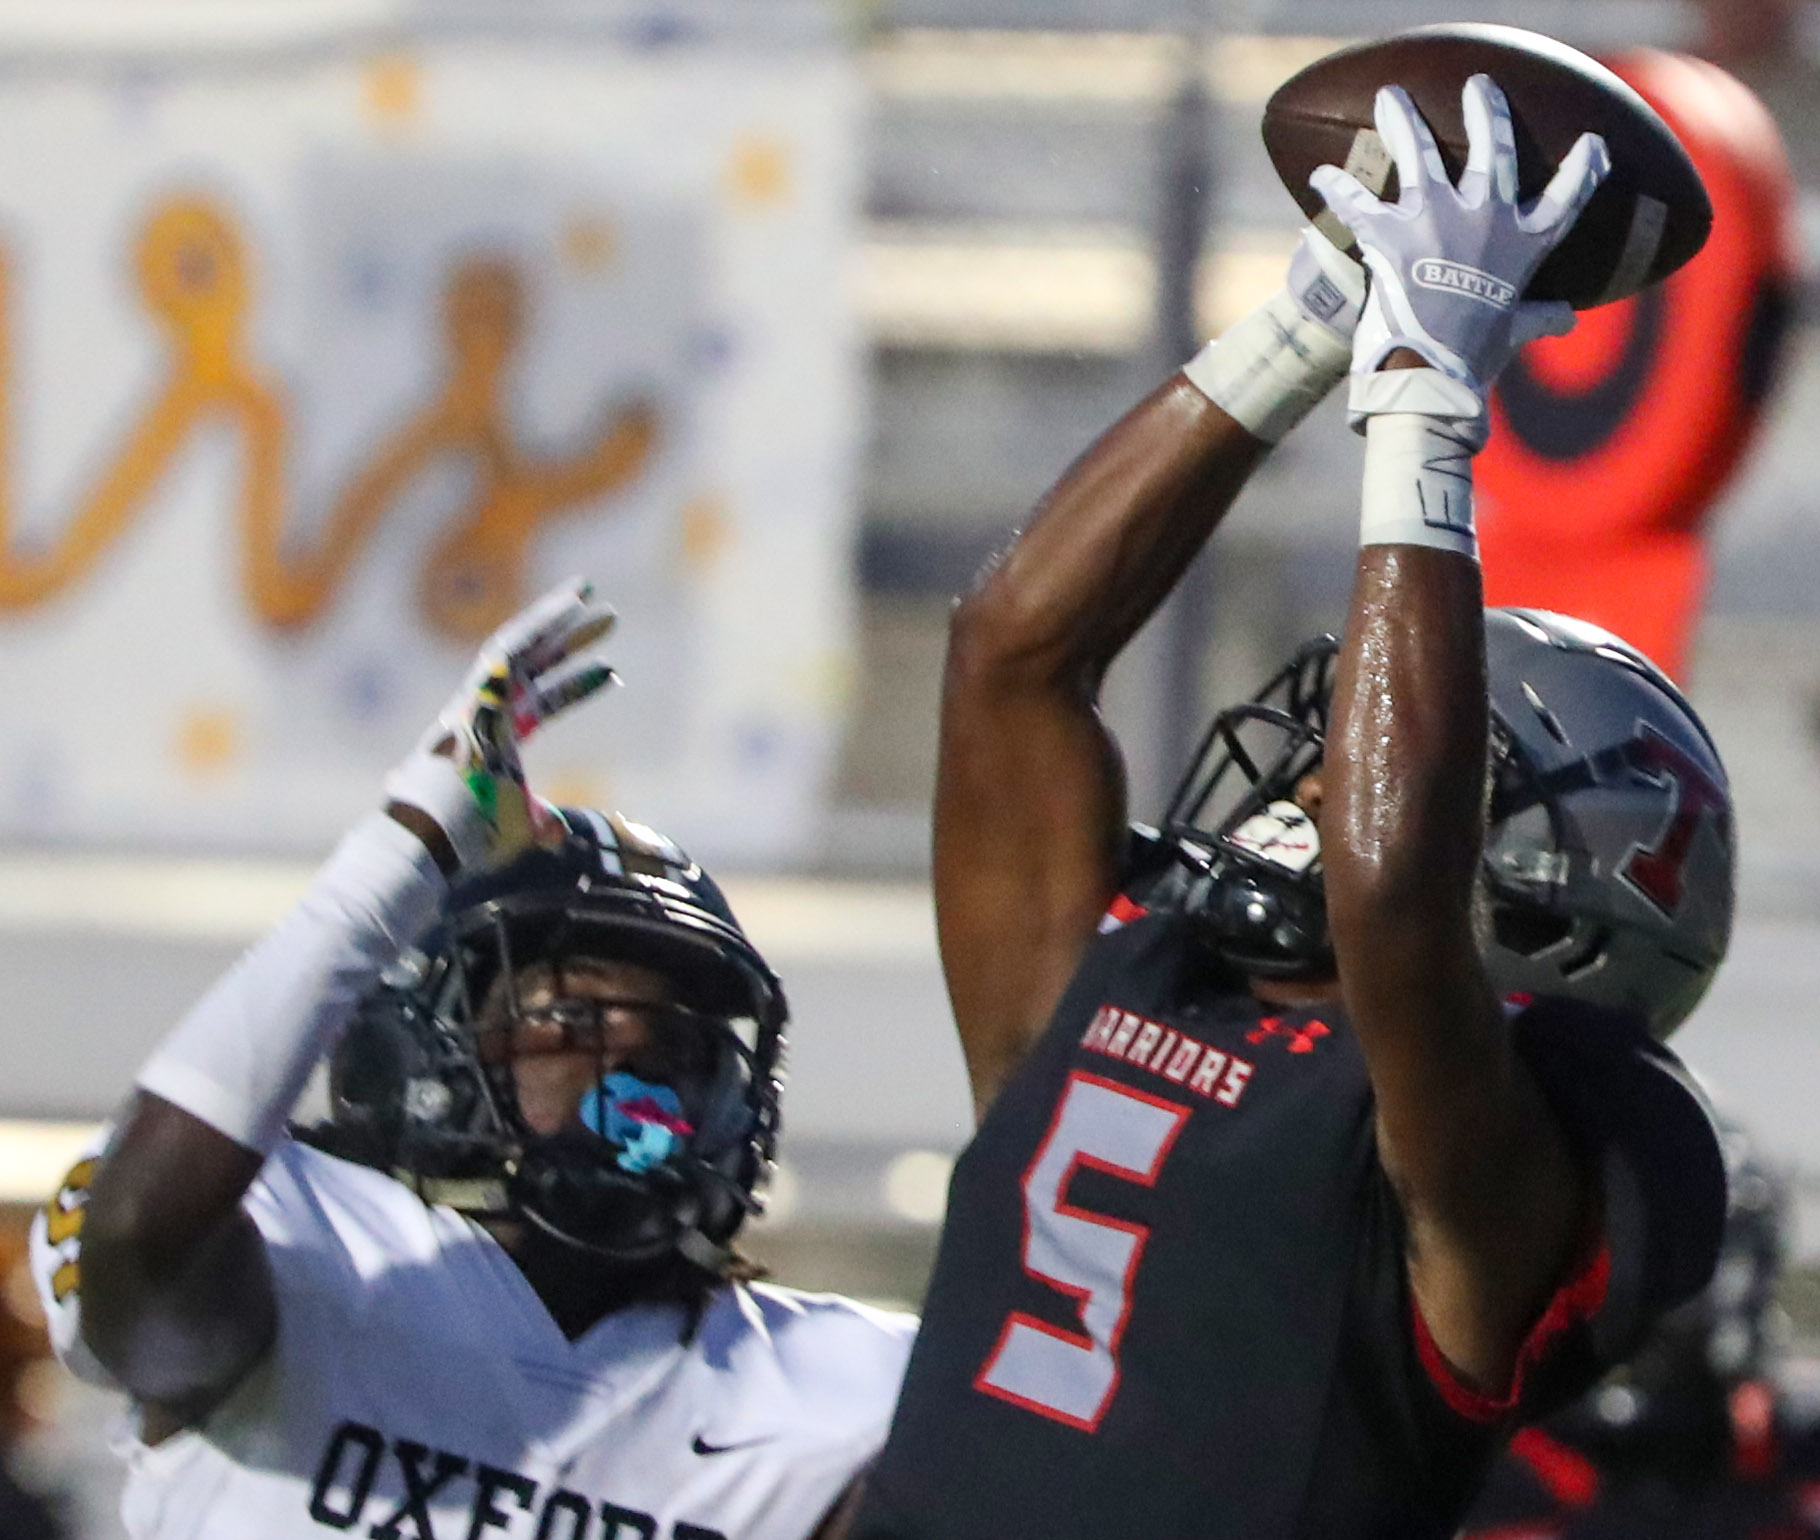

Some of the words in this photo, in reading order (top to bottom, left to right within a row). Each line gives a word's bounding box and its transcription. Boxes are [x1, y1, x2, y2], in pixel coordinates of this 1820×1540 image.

[1424, 264, 1514, 306] BATTLE
[1079, 1004, 1257, 1109] ARRIORS
[973, 1069, 1194, 1434] 5
[308, 1420, 728, 1540] OXFO
